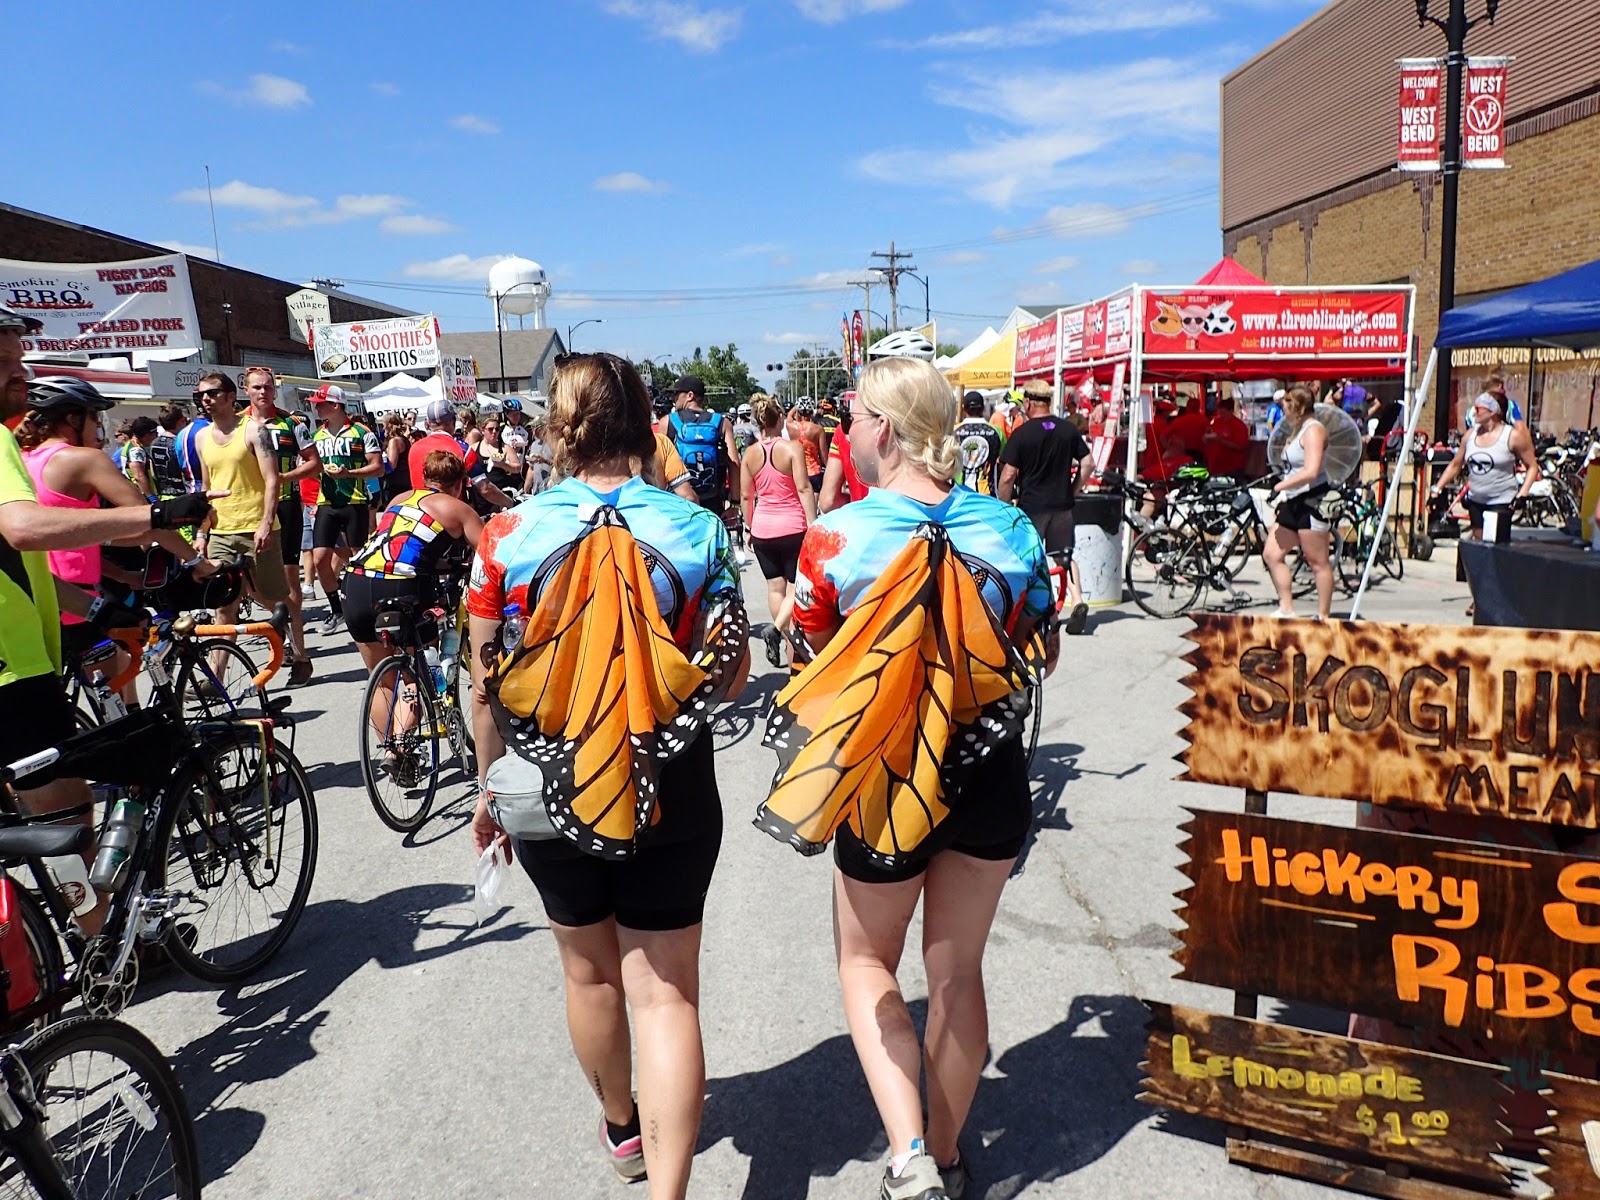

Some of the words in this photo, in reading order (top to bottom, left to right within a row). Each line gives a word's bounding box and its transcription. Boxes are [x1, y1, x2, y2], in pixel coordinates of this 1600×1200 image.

[1402, 76, 1438, 89] WELCOME
[1469, 76, 1503, 94] WEST
[1415, 89, 1425, 101] TO
[1401, 106, 1436, 125] WEST
[1401, 125, 1435, 143] BEND
[1467, 135, 1499, 152] BEND
[96, 269, 138, 282] PIGGY
[139, 265, 176, 279] BACK
[67, 281, 90, 291] G's
[113, 280, 168, 296] NACHOS
[10, 289, 85, 305] BBQ
[290, 301, 327, 311] Villager
[78, 319, 140, 335] PULLED
[141, 318, 185, 332] PORK
[1242, 309, 1397, 334] www.threeblindpigs.com
[36, 336, 112, 351] BRISKET
[114, 334, 168, 349] PHILLY
[350, 329, 432, 353] SMOOTHIES
[350, 349, 417, 371] BURRITOS
[1469, 347, 1498, 366] DECOR
[1503, 347, 1530, 363] GIFTS
[973, 371, 990, 380] SAY
